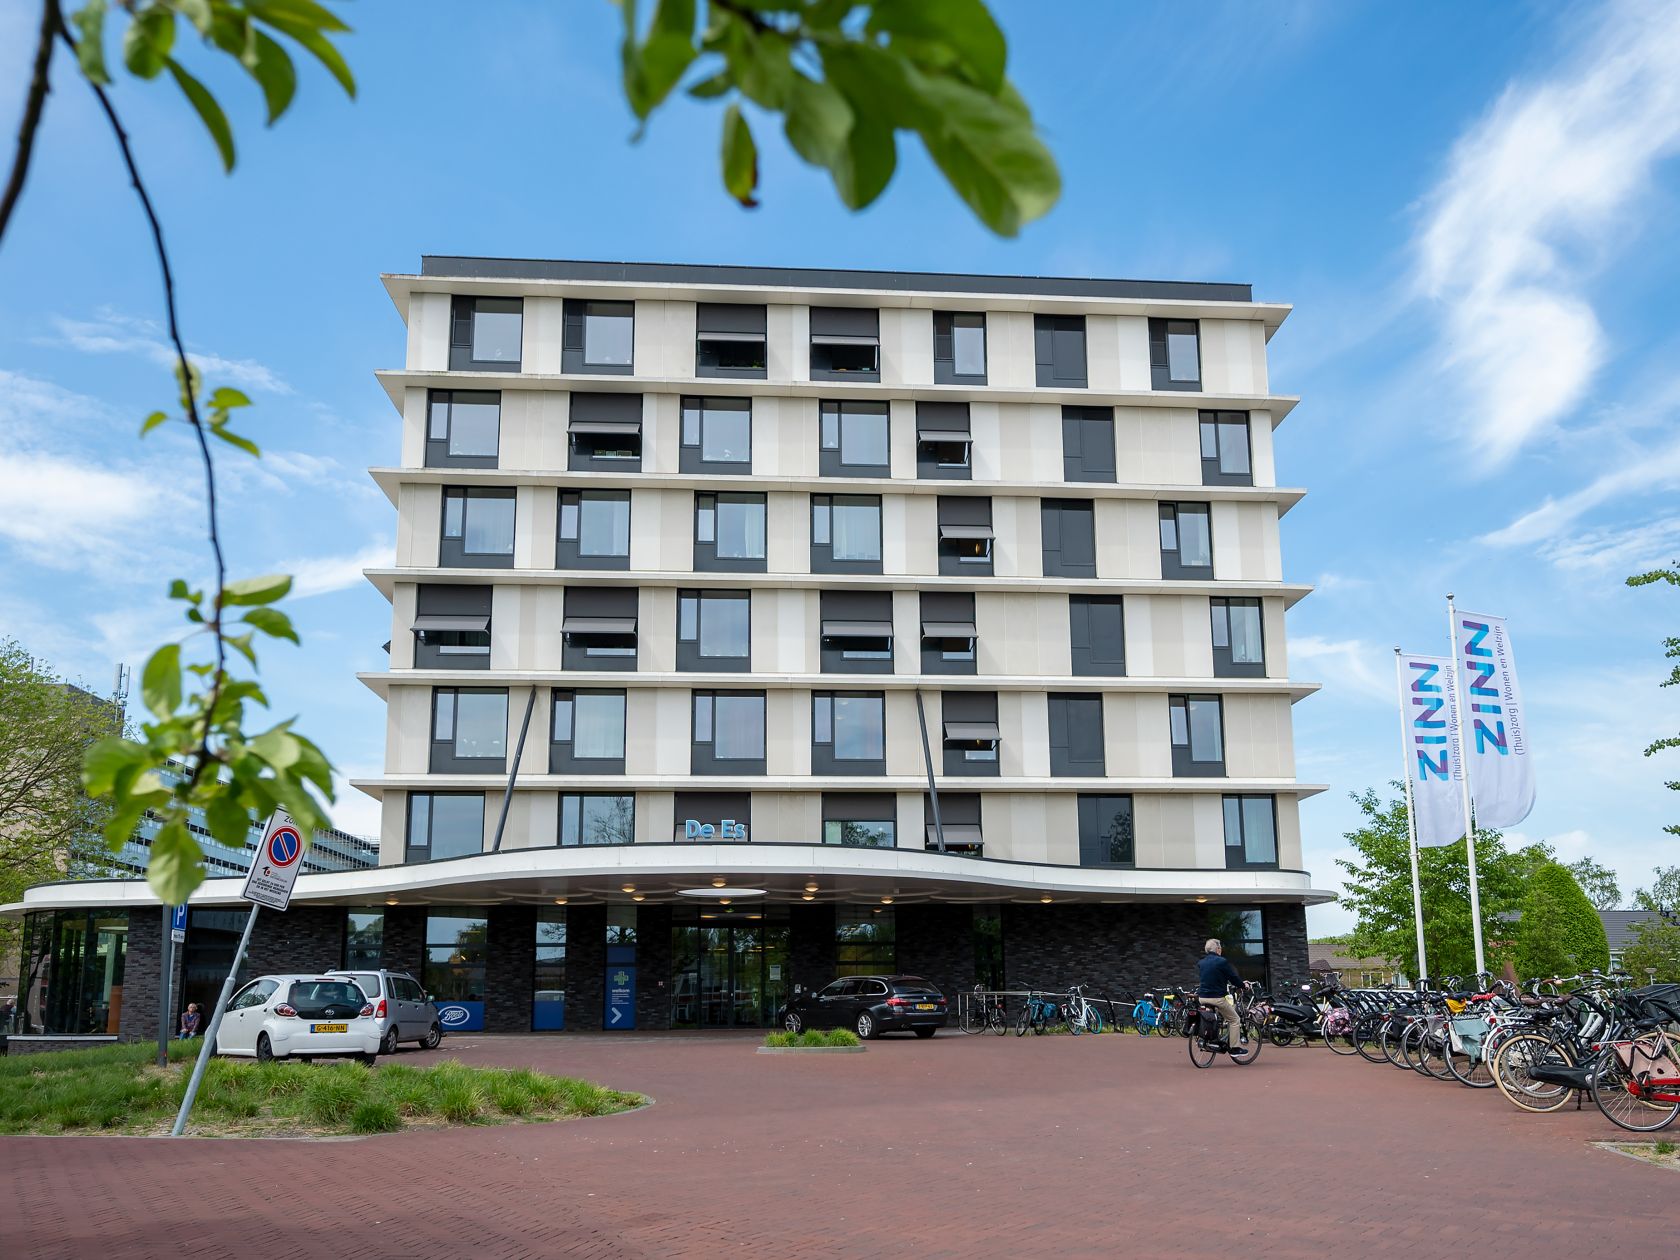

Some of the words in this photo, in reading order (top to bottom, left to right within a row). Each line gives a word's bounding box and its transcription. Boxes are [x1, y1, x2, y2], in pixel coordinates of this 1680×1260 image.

[1494, 625, 1506, 656] Welzijn
[1500, 658, 1508, 669] en
[1445, 665, 1456, 693] Welzijn
[1463, 620, 1508, 755] ZINN
[1503, 671, 1514, 701] Wonen
[1449, 693, 1457, 702] en
[1409, 662, 1449, 781] ZINN
[1450, 705, 1459, 732] Wonen
[1508, 708, 1525, 756] (Thuis)zorg
[686, 820, 715, 839] De
[722, 820, 745, 839] Es
[176, 904, 185, 925] P
